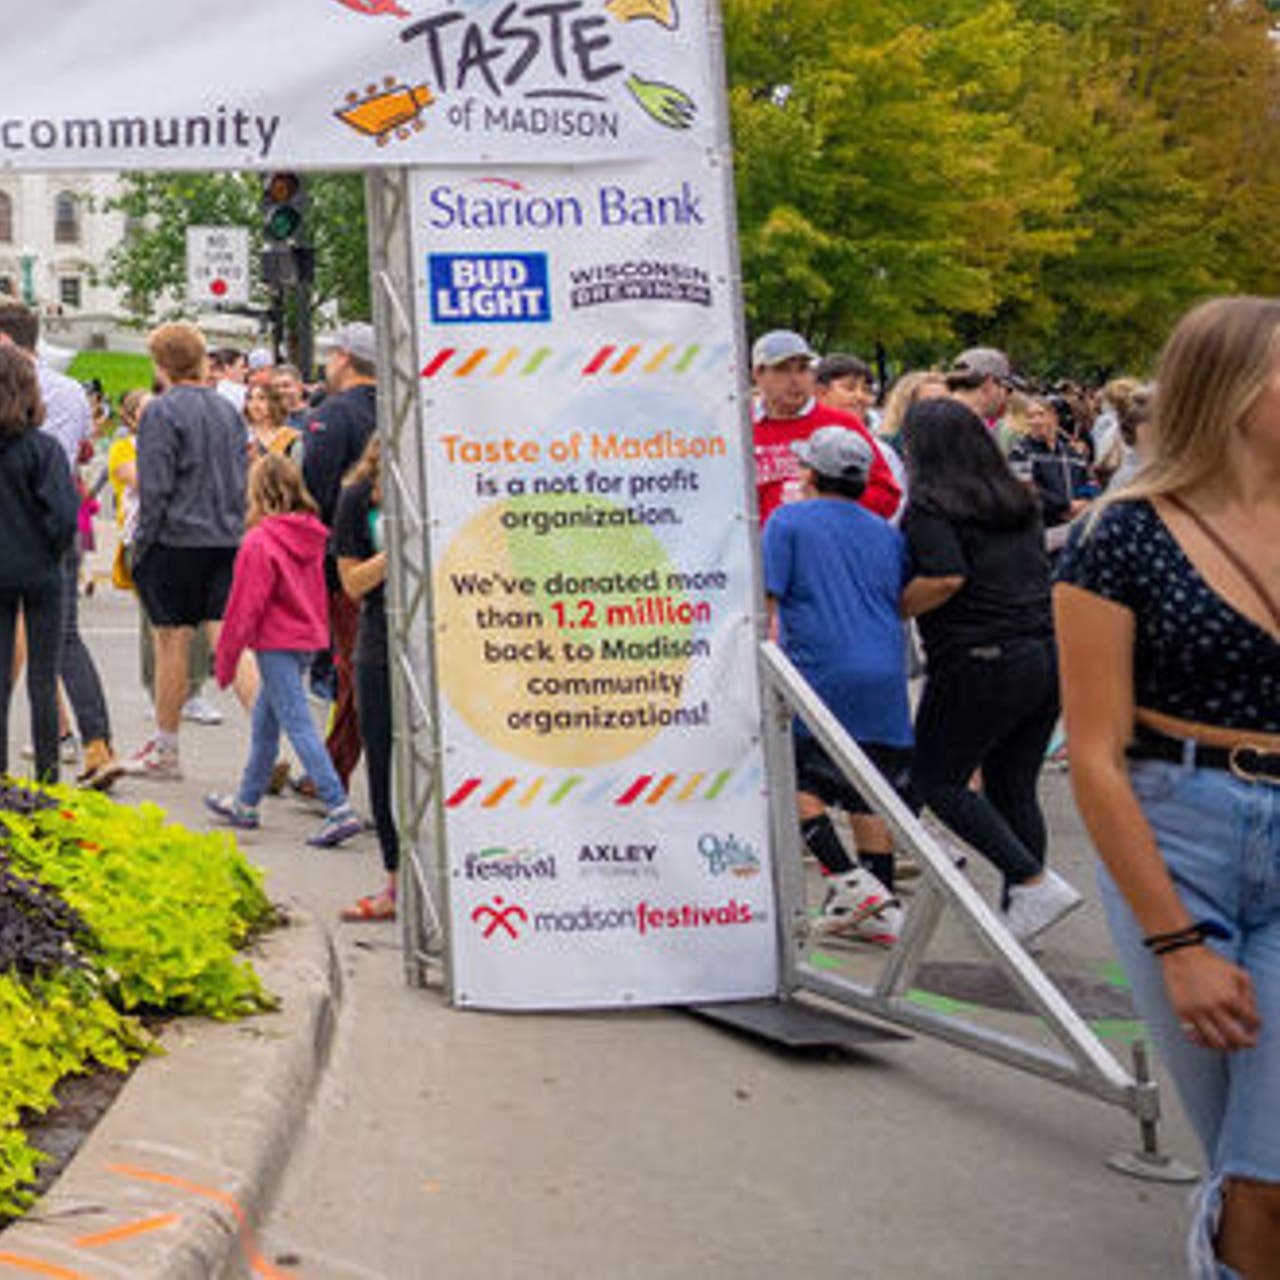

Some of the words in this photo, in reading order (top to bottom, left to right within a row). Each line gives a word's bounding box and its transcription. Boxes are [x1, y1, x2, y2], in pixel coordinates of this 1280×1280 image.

[400, 0, 624, 96] TASTE
[2, 105, 281, 157] community
[449, 98, 476, 130] of
[484, 107, 619, 139] MADISON
[428, 184, 583, 230] Starion
[599, 180, 705, 227] Bank
[450, 258, 528, 287] BUD
[570, 260, 708, 285] WISCONSIN
[438, 288, 544, 318] LIGHT
[441, 434, 540, 465] Taste
[549, 433, 583, 463] of
[591, 430, 728, 462] Madison
[476, 473, 498, 497] is
[507, 478, 526, 495] a
[534, 472, 578, 495] not
[585, 469, 623, 493] for
[628, 468, 700, 497] profit
[500, 502, 683, 536] organization.
[450, 572, 536, 597] We've
[544, 571, 660, 596] donated
[666, 571, 728, 591] more
[476, 607, 544, 630] than
[550, 600, 598, 629] 1.2
[606, 596, 712, 627] million
[483, 640, 556, 663] back
[564, 640, 595, 661] to
[601, 637, 712, 660] Madison
[526, 670, 685, 698] community
[506, 702, 710, 735] organizations!
[578, 844, 658, 862] AXLEY
